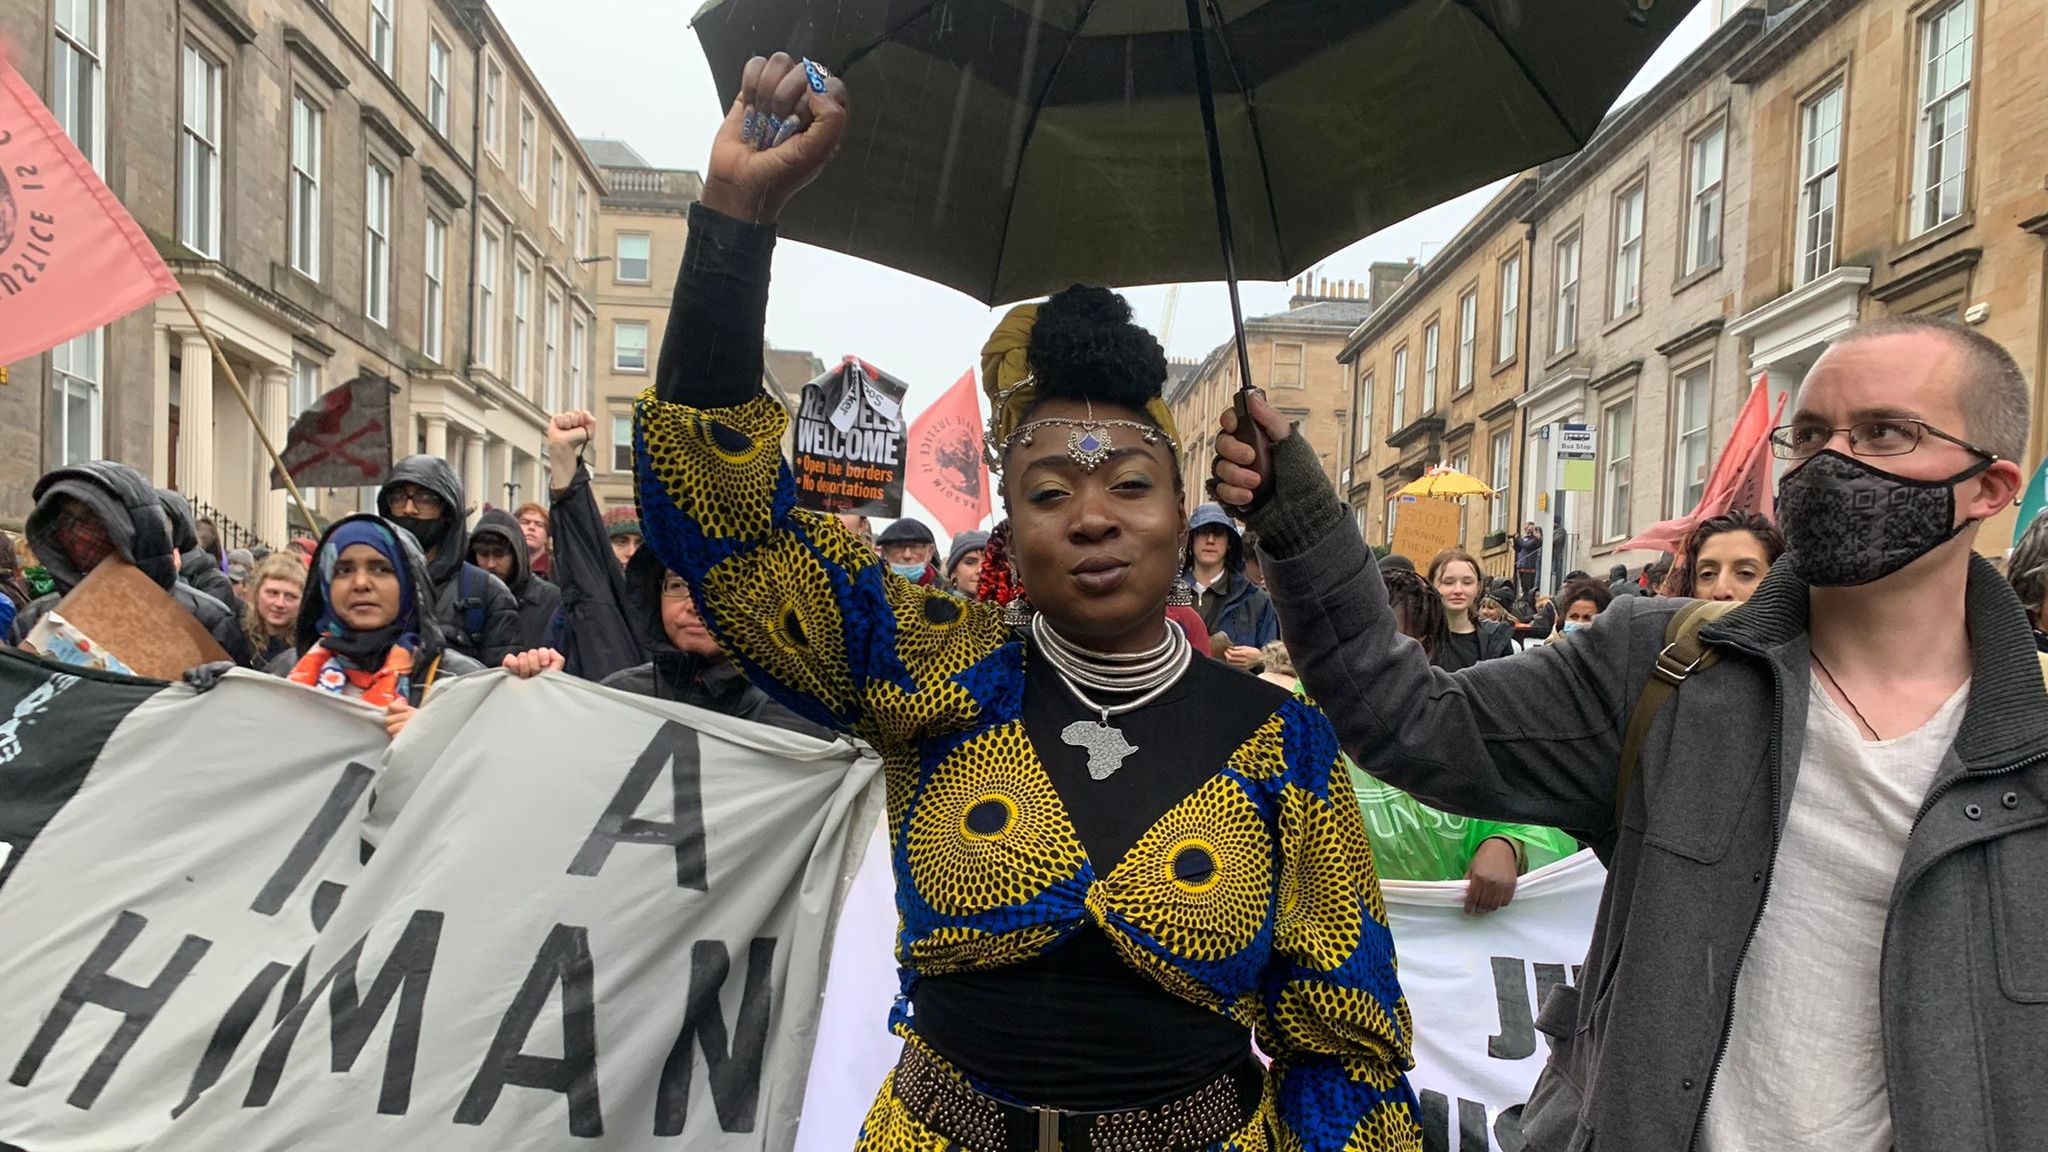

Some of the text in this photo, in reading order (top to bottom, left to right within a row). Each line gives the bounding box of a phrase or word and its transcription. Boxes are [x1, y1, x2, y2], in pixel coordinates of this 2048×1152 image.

[798, 417, 900, 465] WELCOME
[1576, 443, 1592, 451] Stop
[804, 454, 826, 474] Open
[846, 461, 894, 482] borders
[803, 474, 815, 492] No
[1406, 510, 1449, 528] STOP
[567, 720, 708, 890] A
